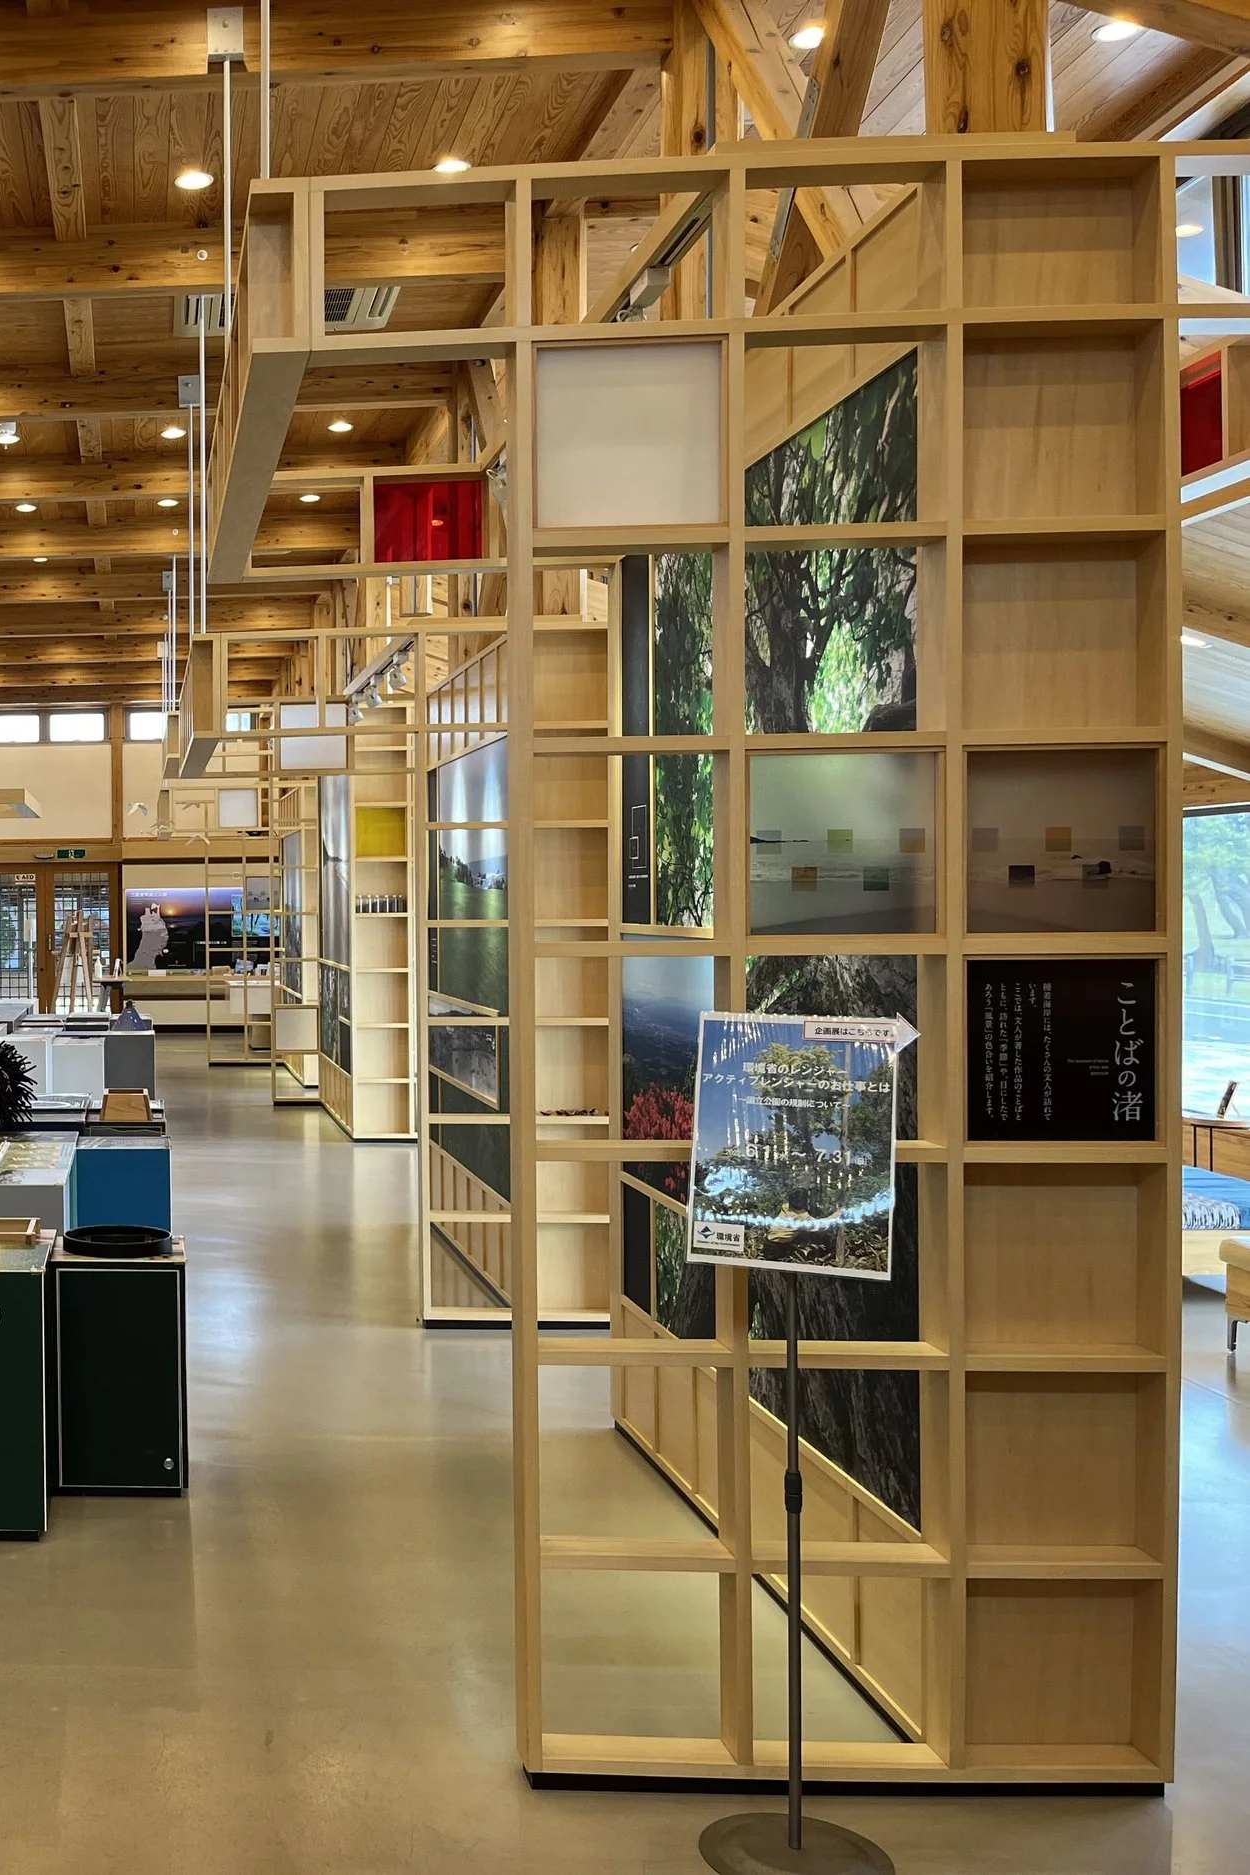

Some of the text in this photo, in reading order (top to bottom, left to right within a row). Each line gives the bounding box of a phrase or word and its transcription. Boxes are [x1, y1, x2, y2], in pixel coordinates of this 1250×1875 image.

[814, 1026, 895, 1038] 企画展はこちらです。
[1112, 982, 1143, 1121] ことばの渚
[716, 1232, 740, 1242] 環境省
